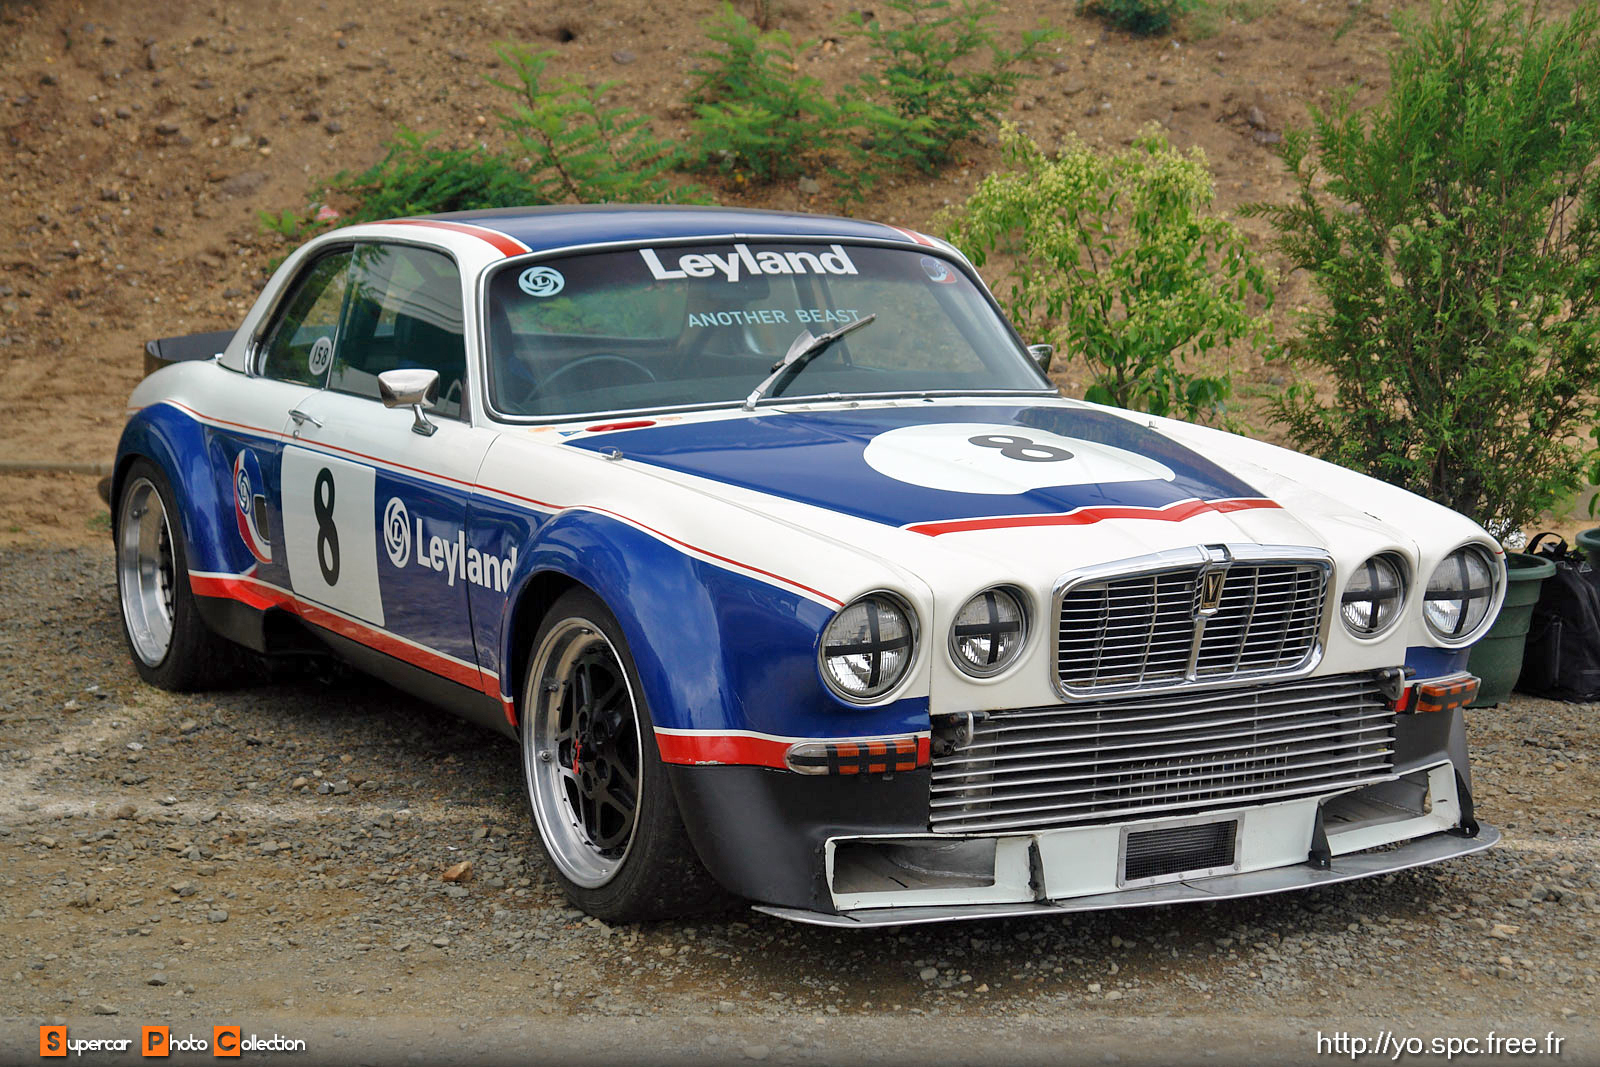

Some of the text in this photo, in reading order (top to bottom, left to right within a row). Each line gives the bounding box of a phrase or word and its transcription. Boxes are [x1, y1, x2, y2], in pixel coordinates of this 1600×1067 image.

[639, 243, 859, 283] Leyland
[688, 309, 859, 328] ANOTHER BEAST
[312, 345, 329, 367] 158
[967, 434, 1074, 462] 8
[313, 467, 341, 588] 8
[416, 517, 518, 594] Leyland
